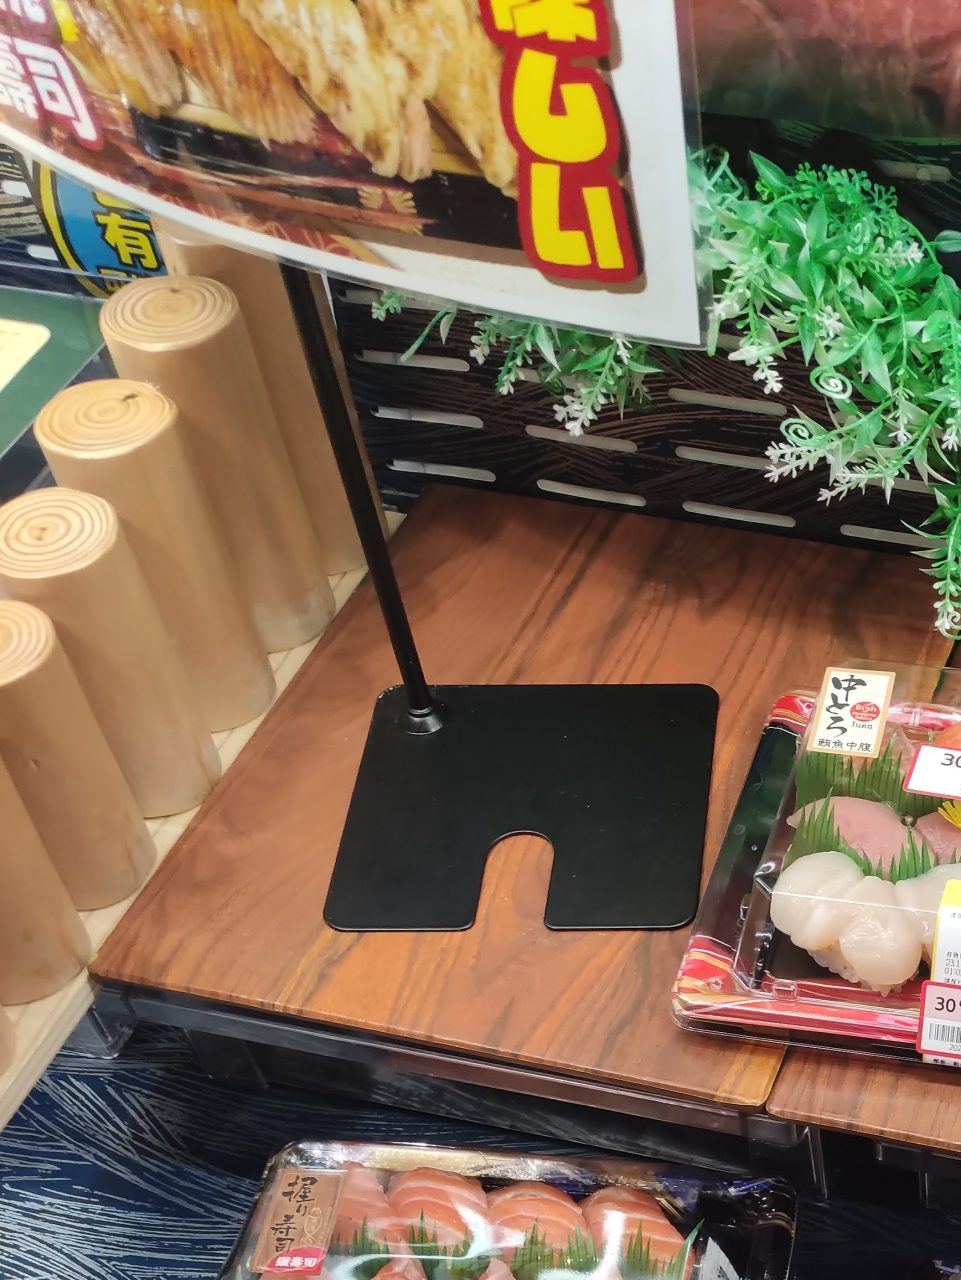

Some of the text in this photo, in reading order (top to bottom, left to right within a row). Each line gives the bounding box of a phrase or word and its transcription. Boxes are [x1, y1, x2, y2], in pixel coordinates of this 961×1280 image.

[825, 674, 867, 737] 中とろ
[851, 721, 873, 730] Tuna
